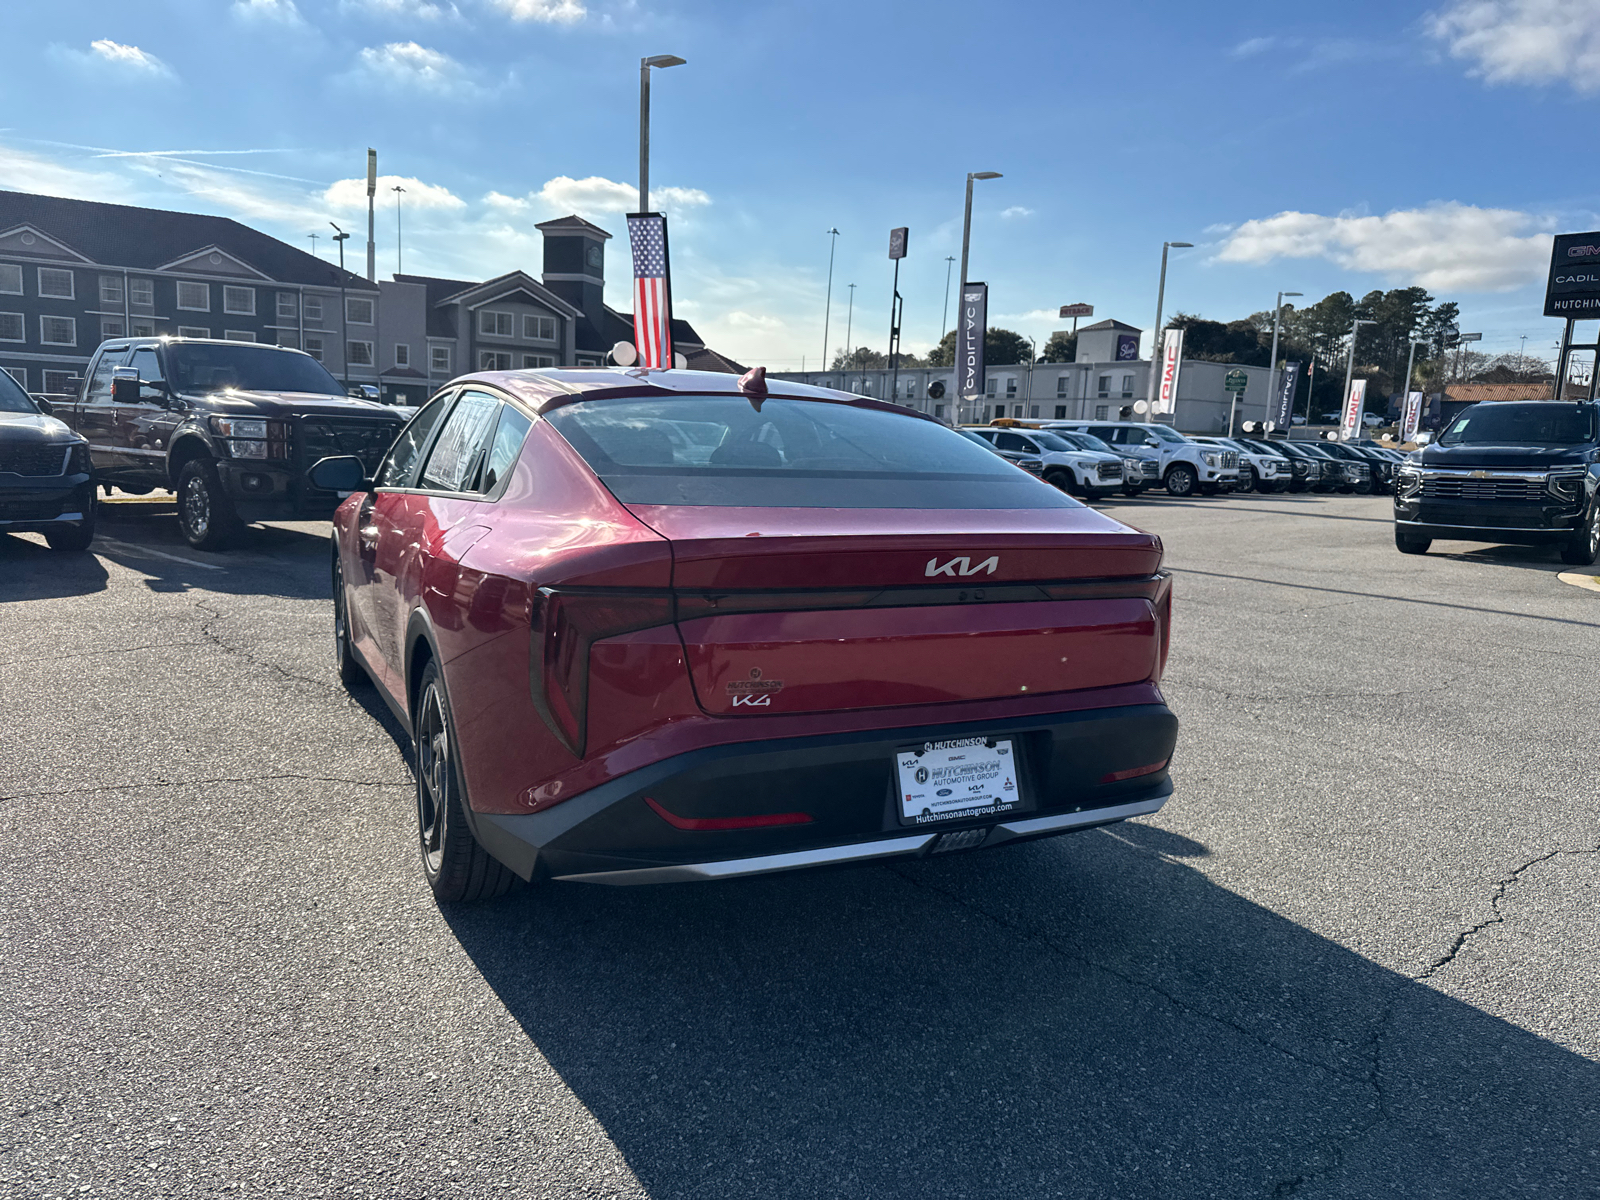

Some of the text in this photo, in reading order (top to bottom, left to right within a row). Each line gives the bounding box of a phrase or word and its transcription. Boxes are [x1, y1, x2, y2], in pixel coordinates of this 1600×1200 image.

[966, 307, 976, 389] CADILLAC
[1162, 346, 1177, 399] GMC
[1280, 374, 1293, 424] CADILLAC
[1348, 391, 1361, 427] GMC
[924, 556, 999, 577] KIA
[732, 694, 771, 707] K4
[934, 736, 988, 750] HUTCHINSON
[933, 771, 999, 787] AUTOMOTIVE GROUP
[915, 803, 1013, 823] Hutchinsonautogroup.com
